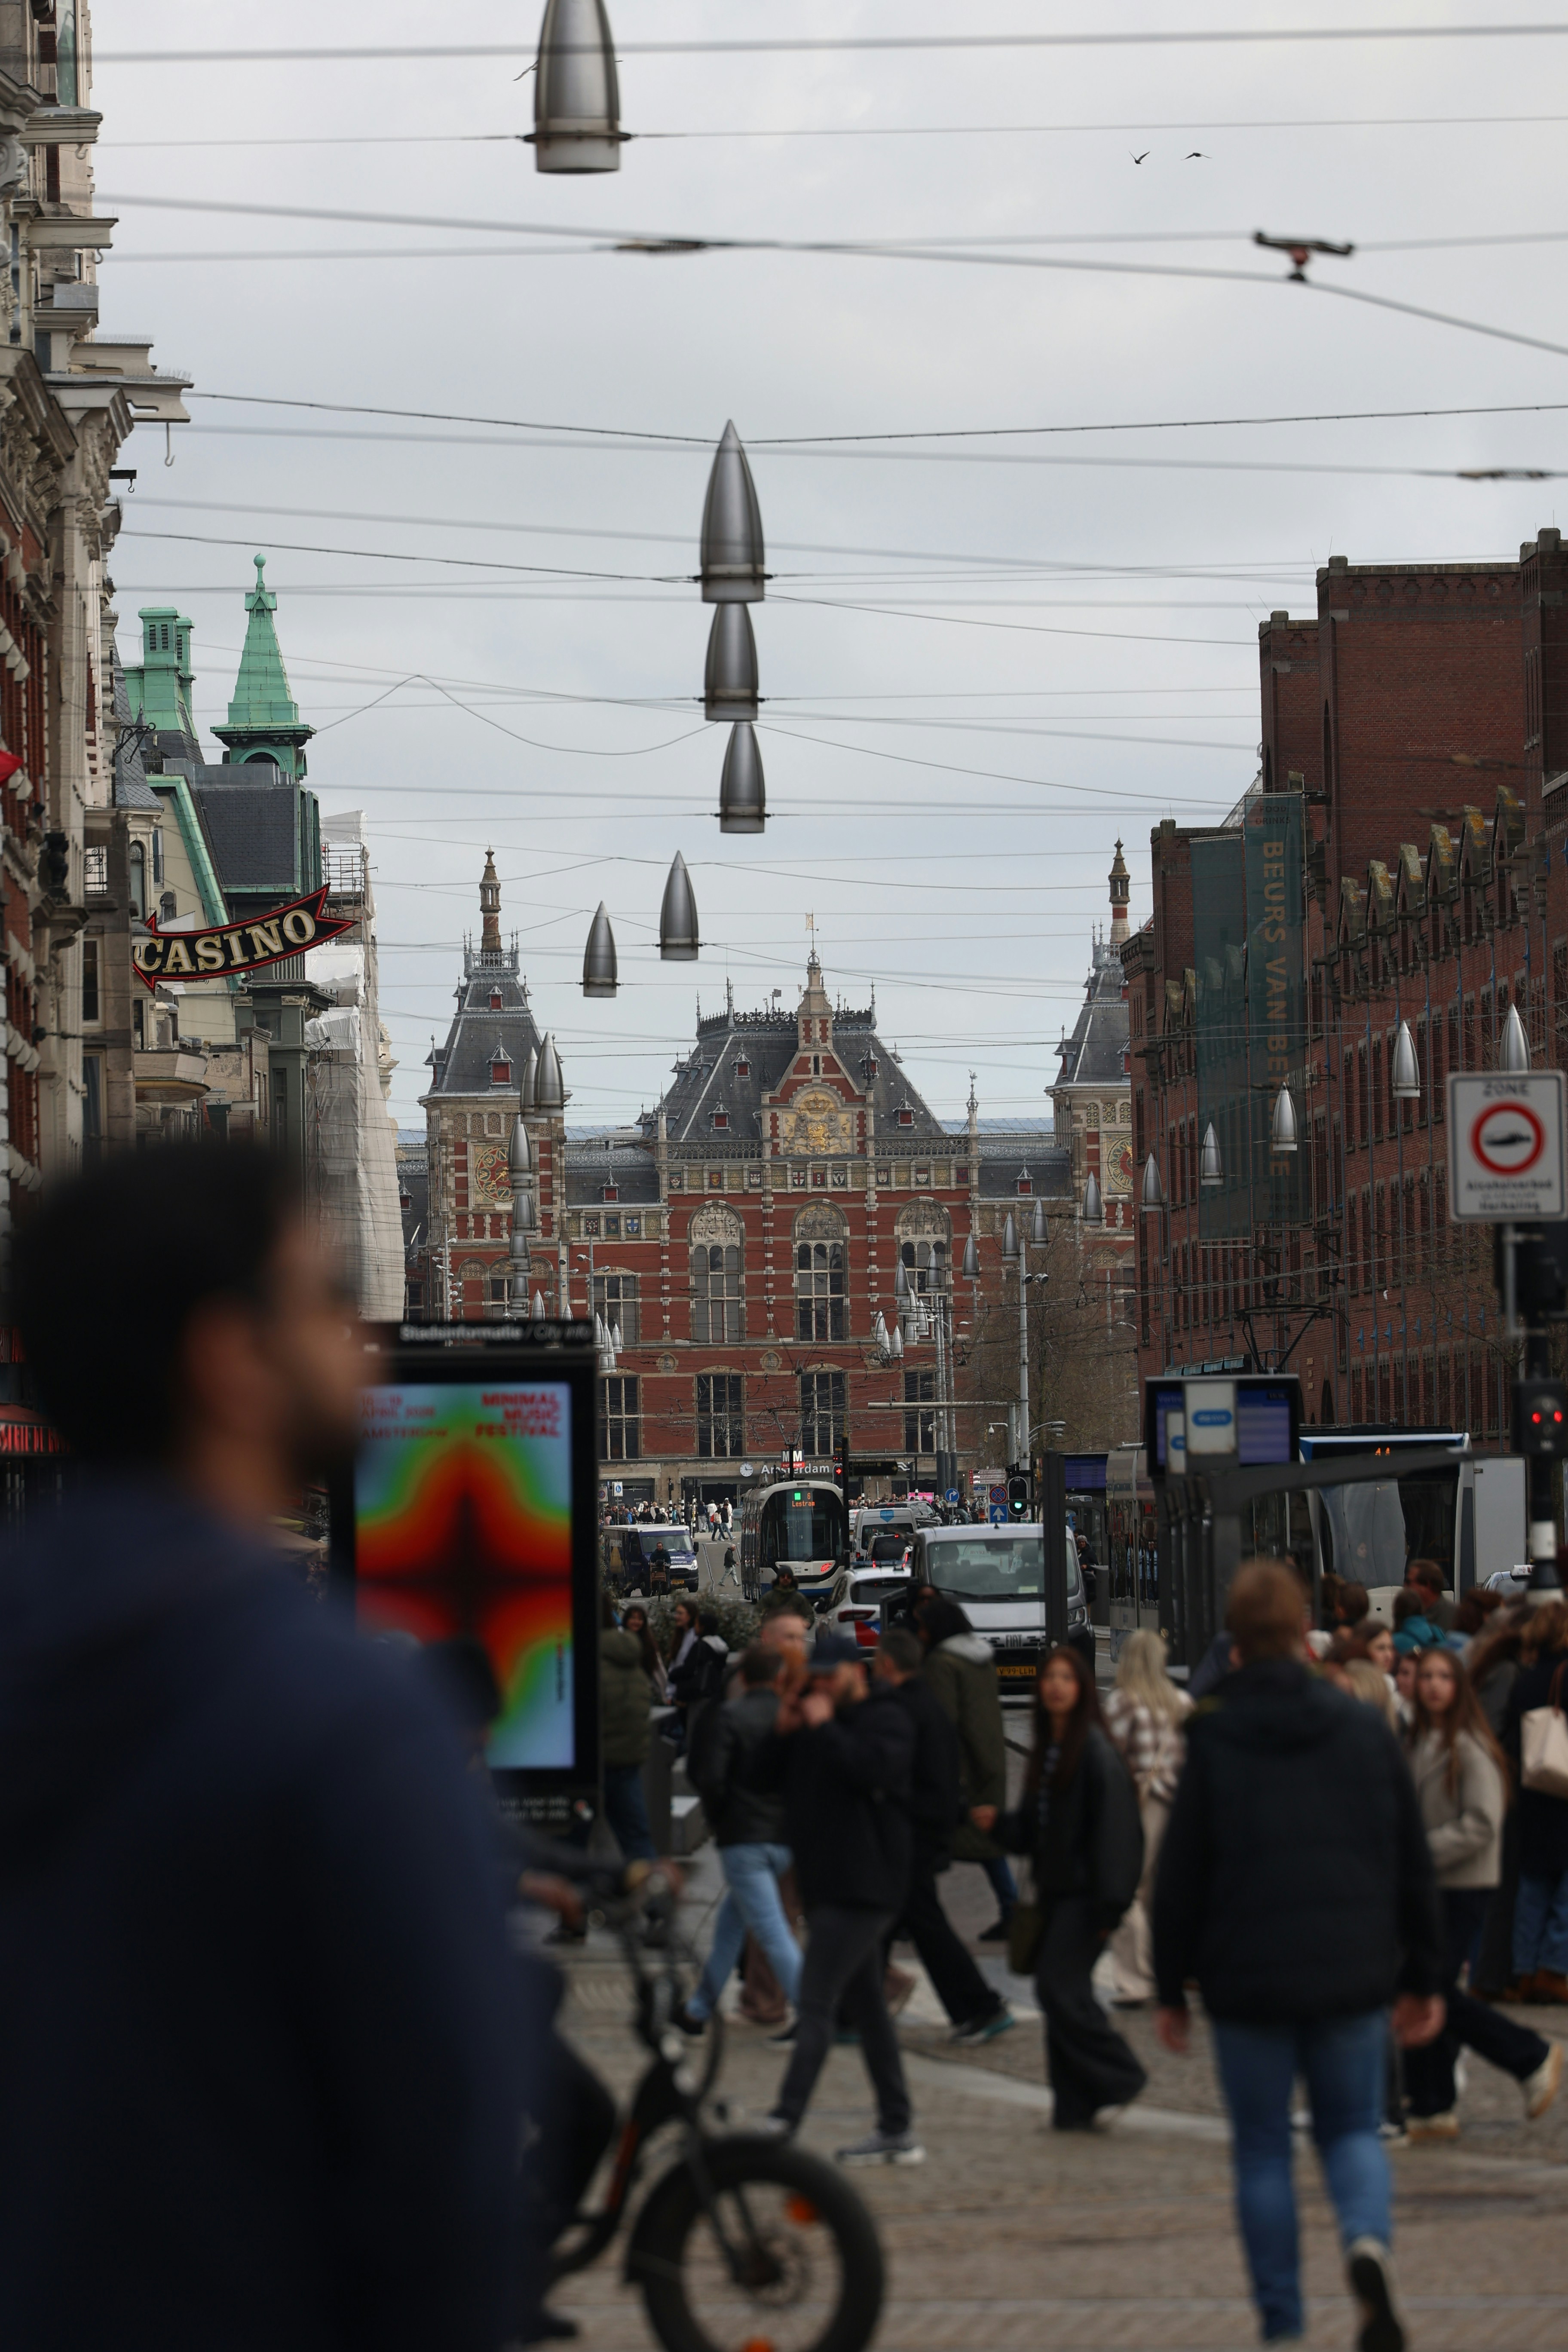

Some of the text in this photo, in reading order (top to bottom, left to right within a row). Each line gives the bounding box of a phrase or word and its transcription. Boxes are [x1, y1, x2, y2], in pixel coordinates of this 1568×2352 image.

[1256, 816, 1291, 825] DRINKS
[1263, 841, 1286, 943] BEURS
[134, 909, 316, 974] CASINO
[1265, 956, 1287, 1019] VAN
[1483, 1081, 1530, 1097] ZONE
[481, 1392, 558, 1406] MINIMAL
[475, 1423, 559, 1437] FESTIVAL
[1005, 1634, 1022, 1648] FIAT
